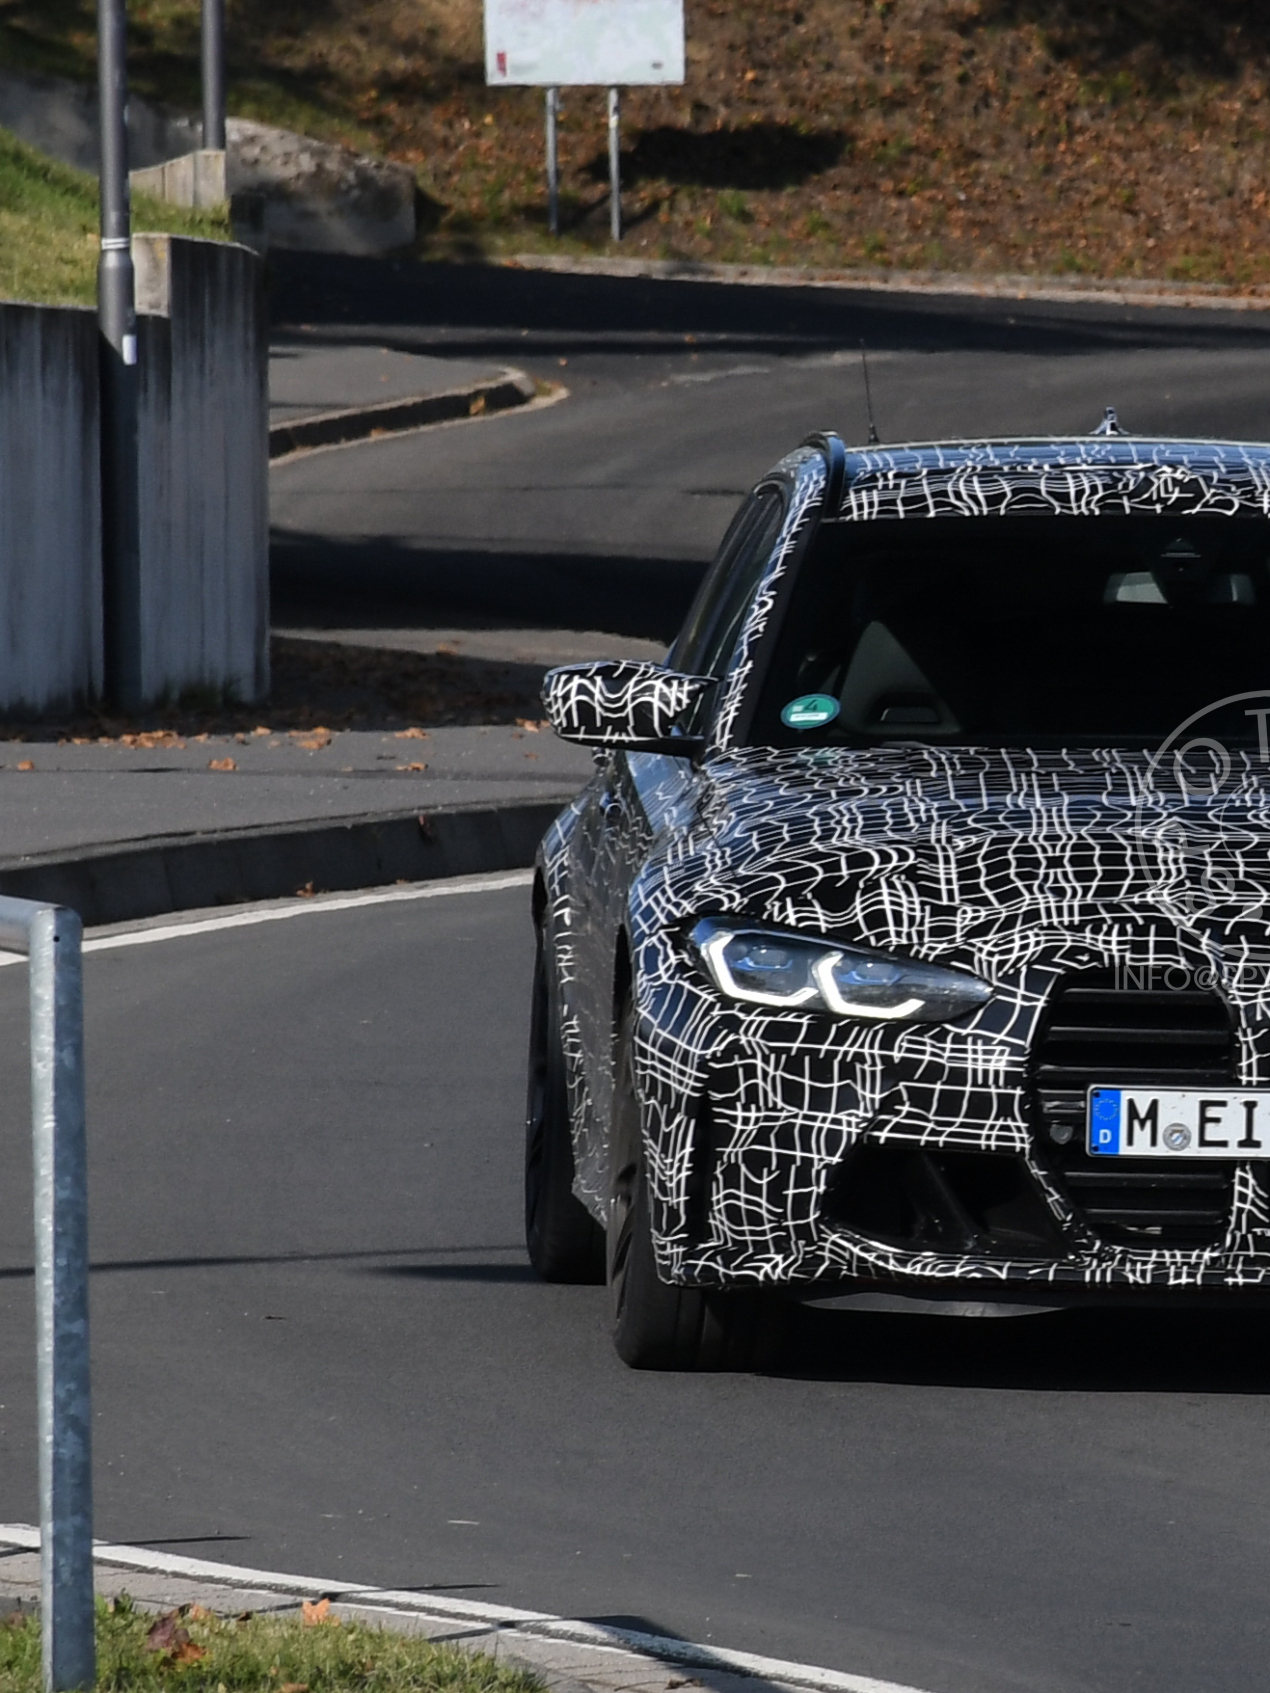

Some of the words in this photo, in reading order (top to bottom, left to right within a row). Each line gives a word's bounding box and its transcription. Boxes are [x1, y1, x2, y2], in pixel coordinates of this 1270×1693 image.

[1098, 1128, 1112, 1144] D
[1126, 1097, 1160, 1147] M
[1197, 1099, 1262, 1149] EI
